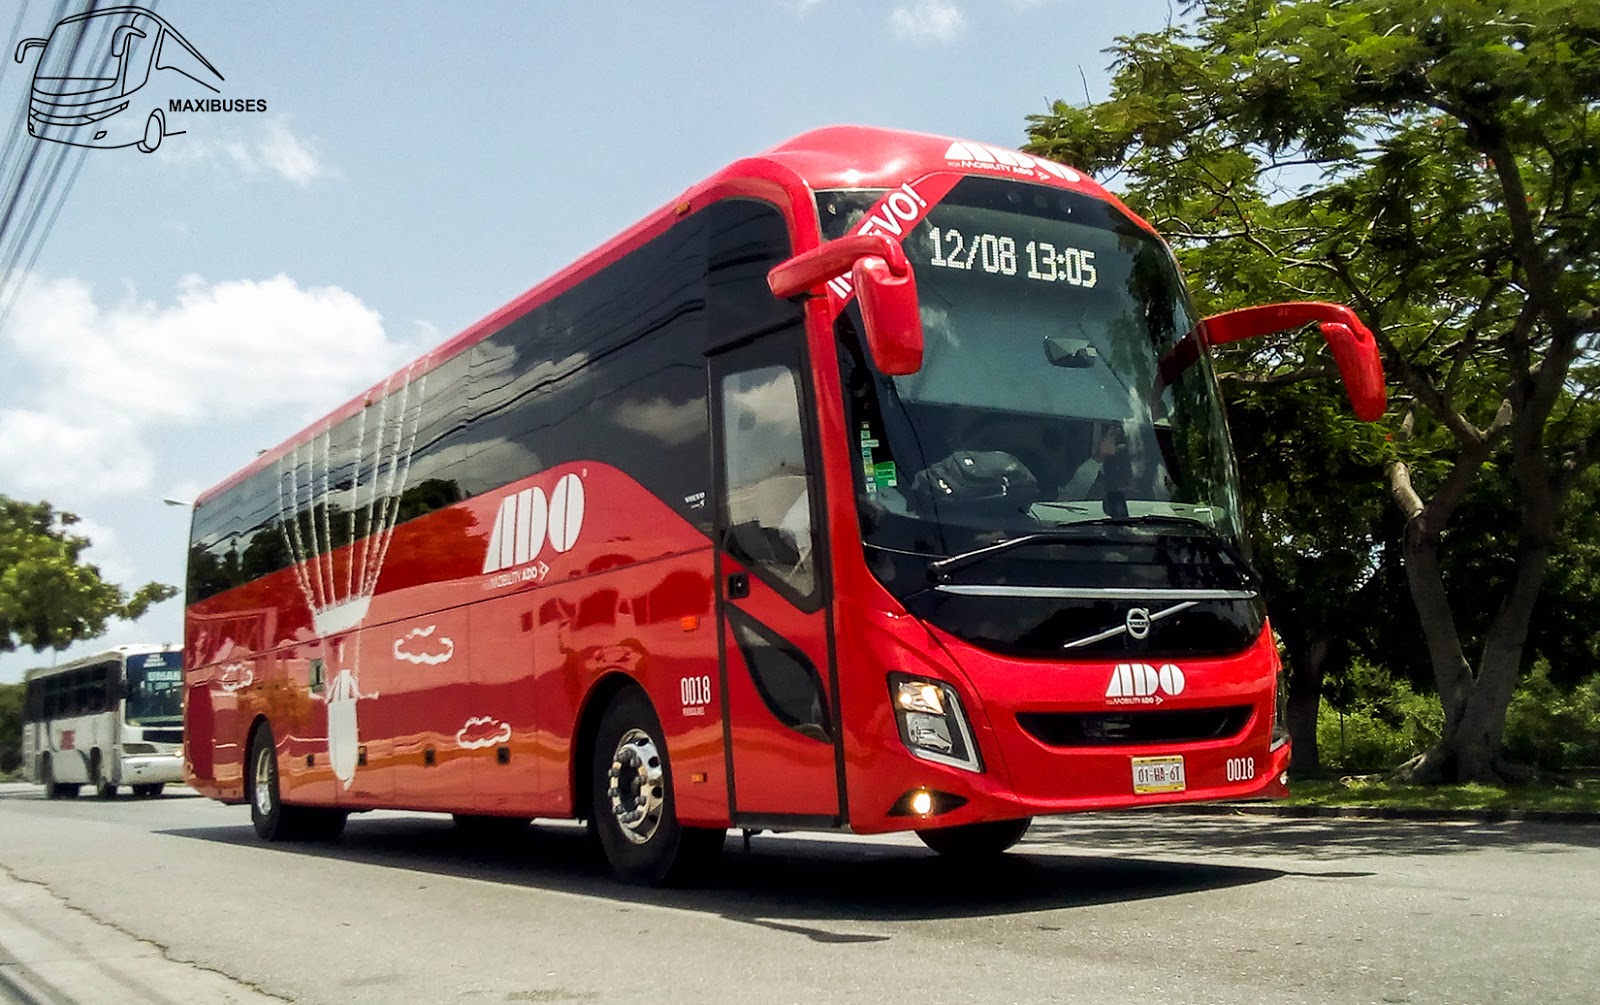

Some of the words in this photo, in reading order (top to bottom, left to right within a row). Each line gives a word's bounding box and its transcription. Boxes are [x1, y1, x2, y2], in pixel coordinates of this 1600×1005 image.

[943, 141, 1081, 182] ADO
[961, 160, 1012, 173] MOBILITY
[928, 226, 1018, 276] 12/08
[1025, 240, 1098, 289] 13:05
[483, 473, 585, 574] ADO
[680, 675, 711, 705] 0018
[1105, 664, 1185, 697] ADO
[1138, 765, 1181, 783] 01-HA-6T
[1226, 756, 1254, 782] 0018
